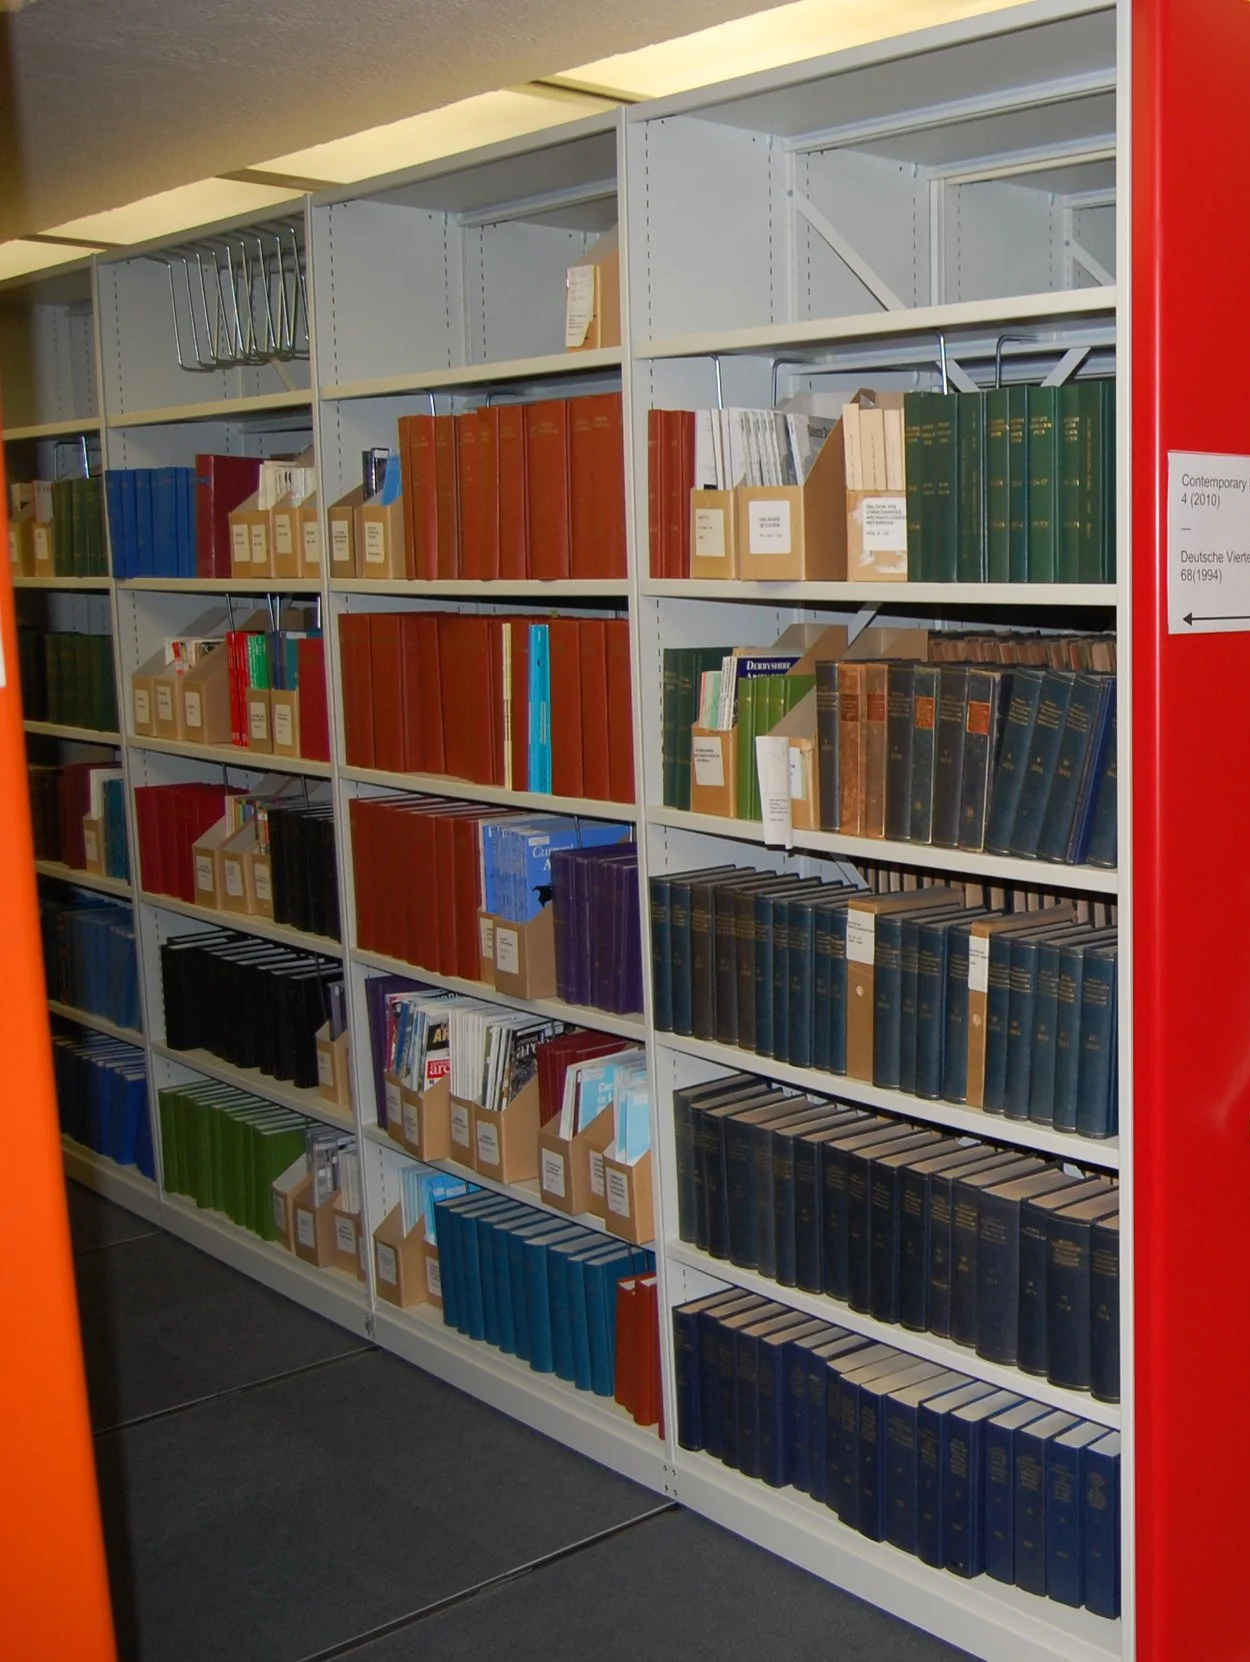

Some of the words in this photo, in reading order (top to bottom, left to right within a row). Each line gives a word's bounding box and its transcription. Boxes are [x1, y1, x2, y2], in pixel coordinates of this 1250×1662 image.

[1181, 474, 1247, 491] Contemporary
[1181, 493, 1188, 505] 4
[1190, 493, 1221, 508] (2010)
[1180, 550, 1224, 564] Deutsche
[1180, 568, 1223, 583] 68(1994)
